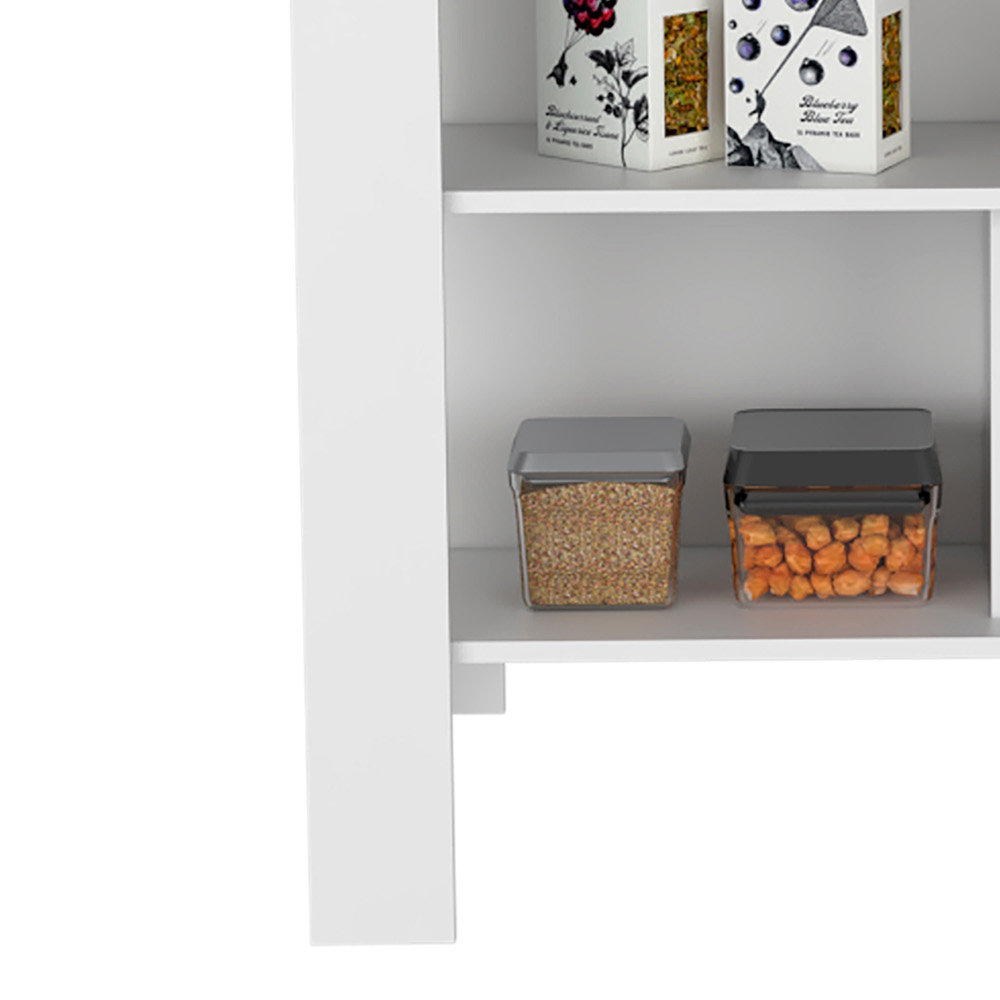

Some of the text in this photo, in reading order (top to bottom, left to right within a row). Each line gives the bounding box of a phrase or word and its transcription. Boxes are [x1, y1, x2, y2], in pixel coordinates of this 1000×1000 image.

[799, 95, 859, 114] Blueberry
[800, 110, 855, 124] Blue Tea
